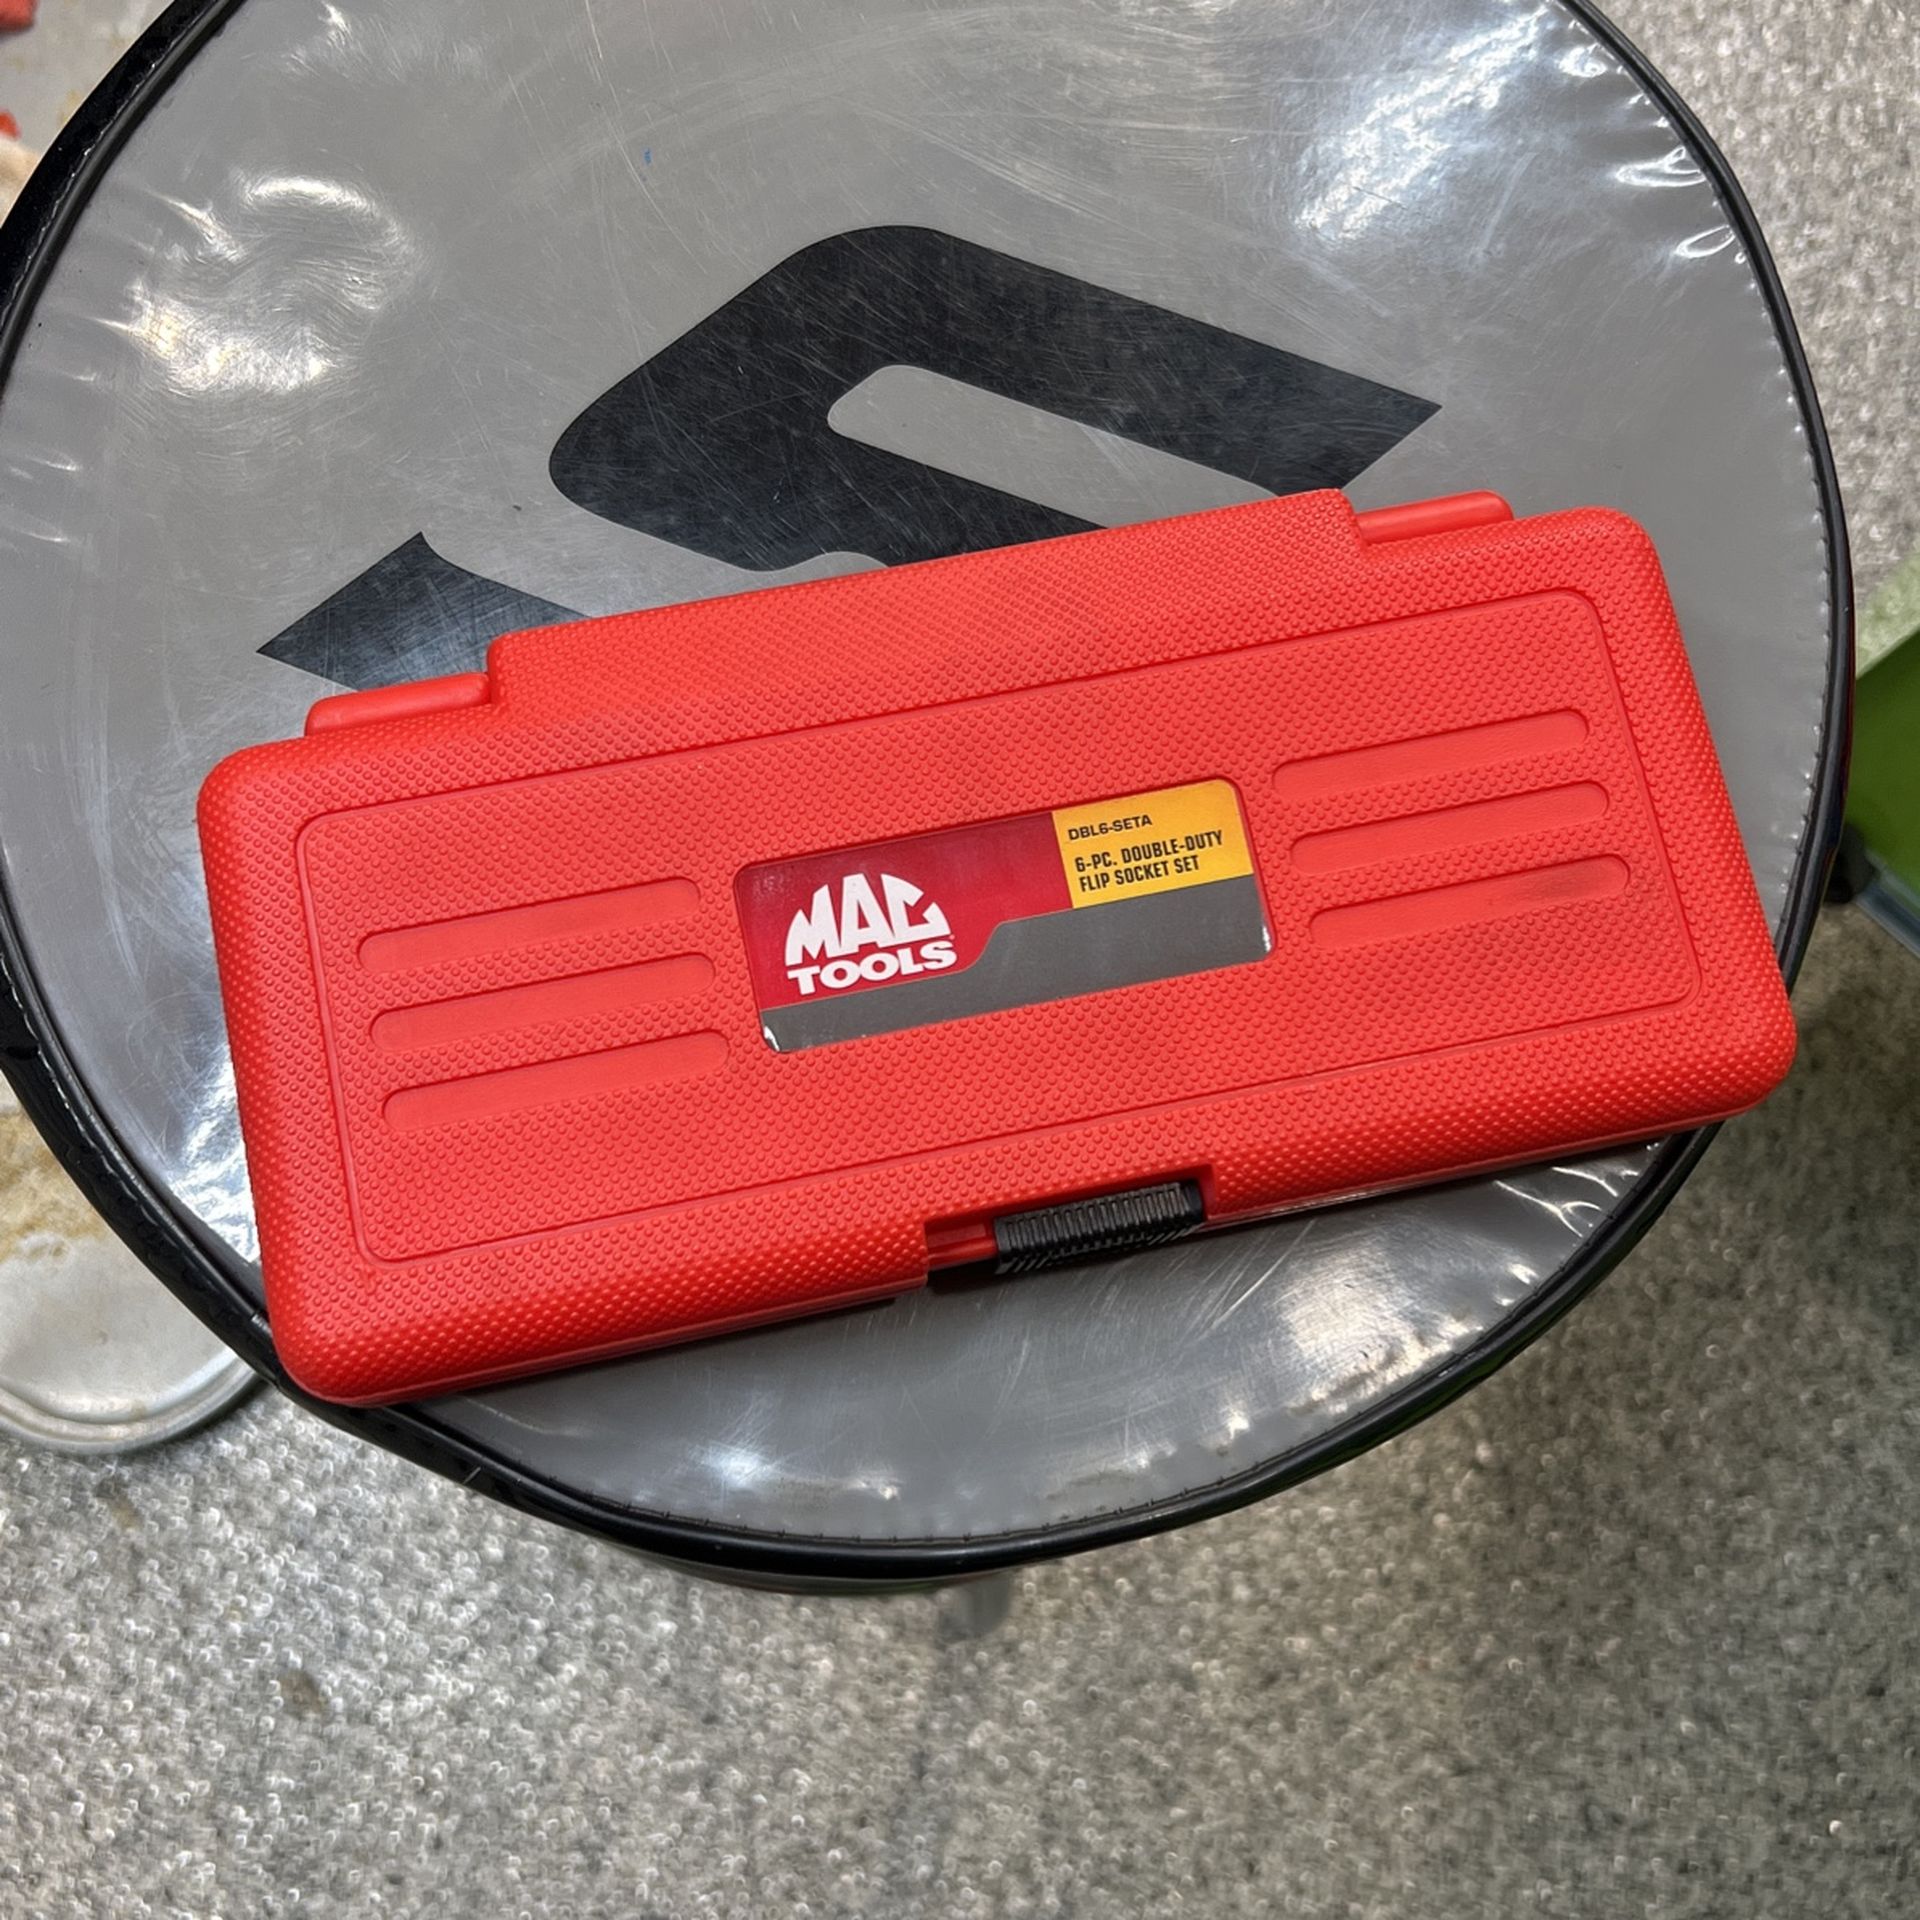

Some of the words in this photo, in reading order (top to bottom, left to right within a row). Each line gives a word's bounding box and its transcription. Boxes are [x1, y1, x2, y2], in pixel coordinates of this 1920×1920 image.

[1068, 814, 1153, 840] DBL6-SETA
[1074, 851, 1118, 873] 6-PC.
[1121, 830, 1223, 864] DOUBLE-DUTY
[1079, 872, 1110, 892] FLIP
[1114, 860, 1170, 885] SOCKET
[1173, 855, 1200, 874] SET
[785, 873, 951, 966] MAC
[787, 940, 957, 995] TOOLS
